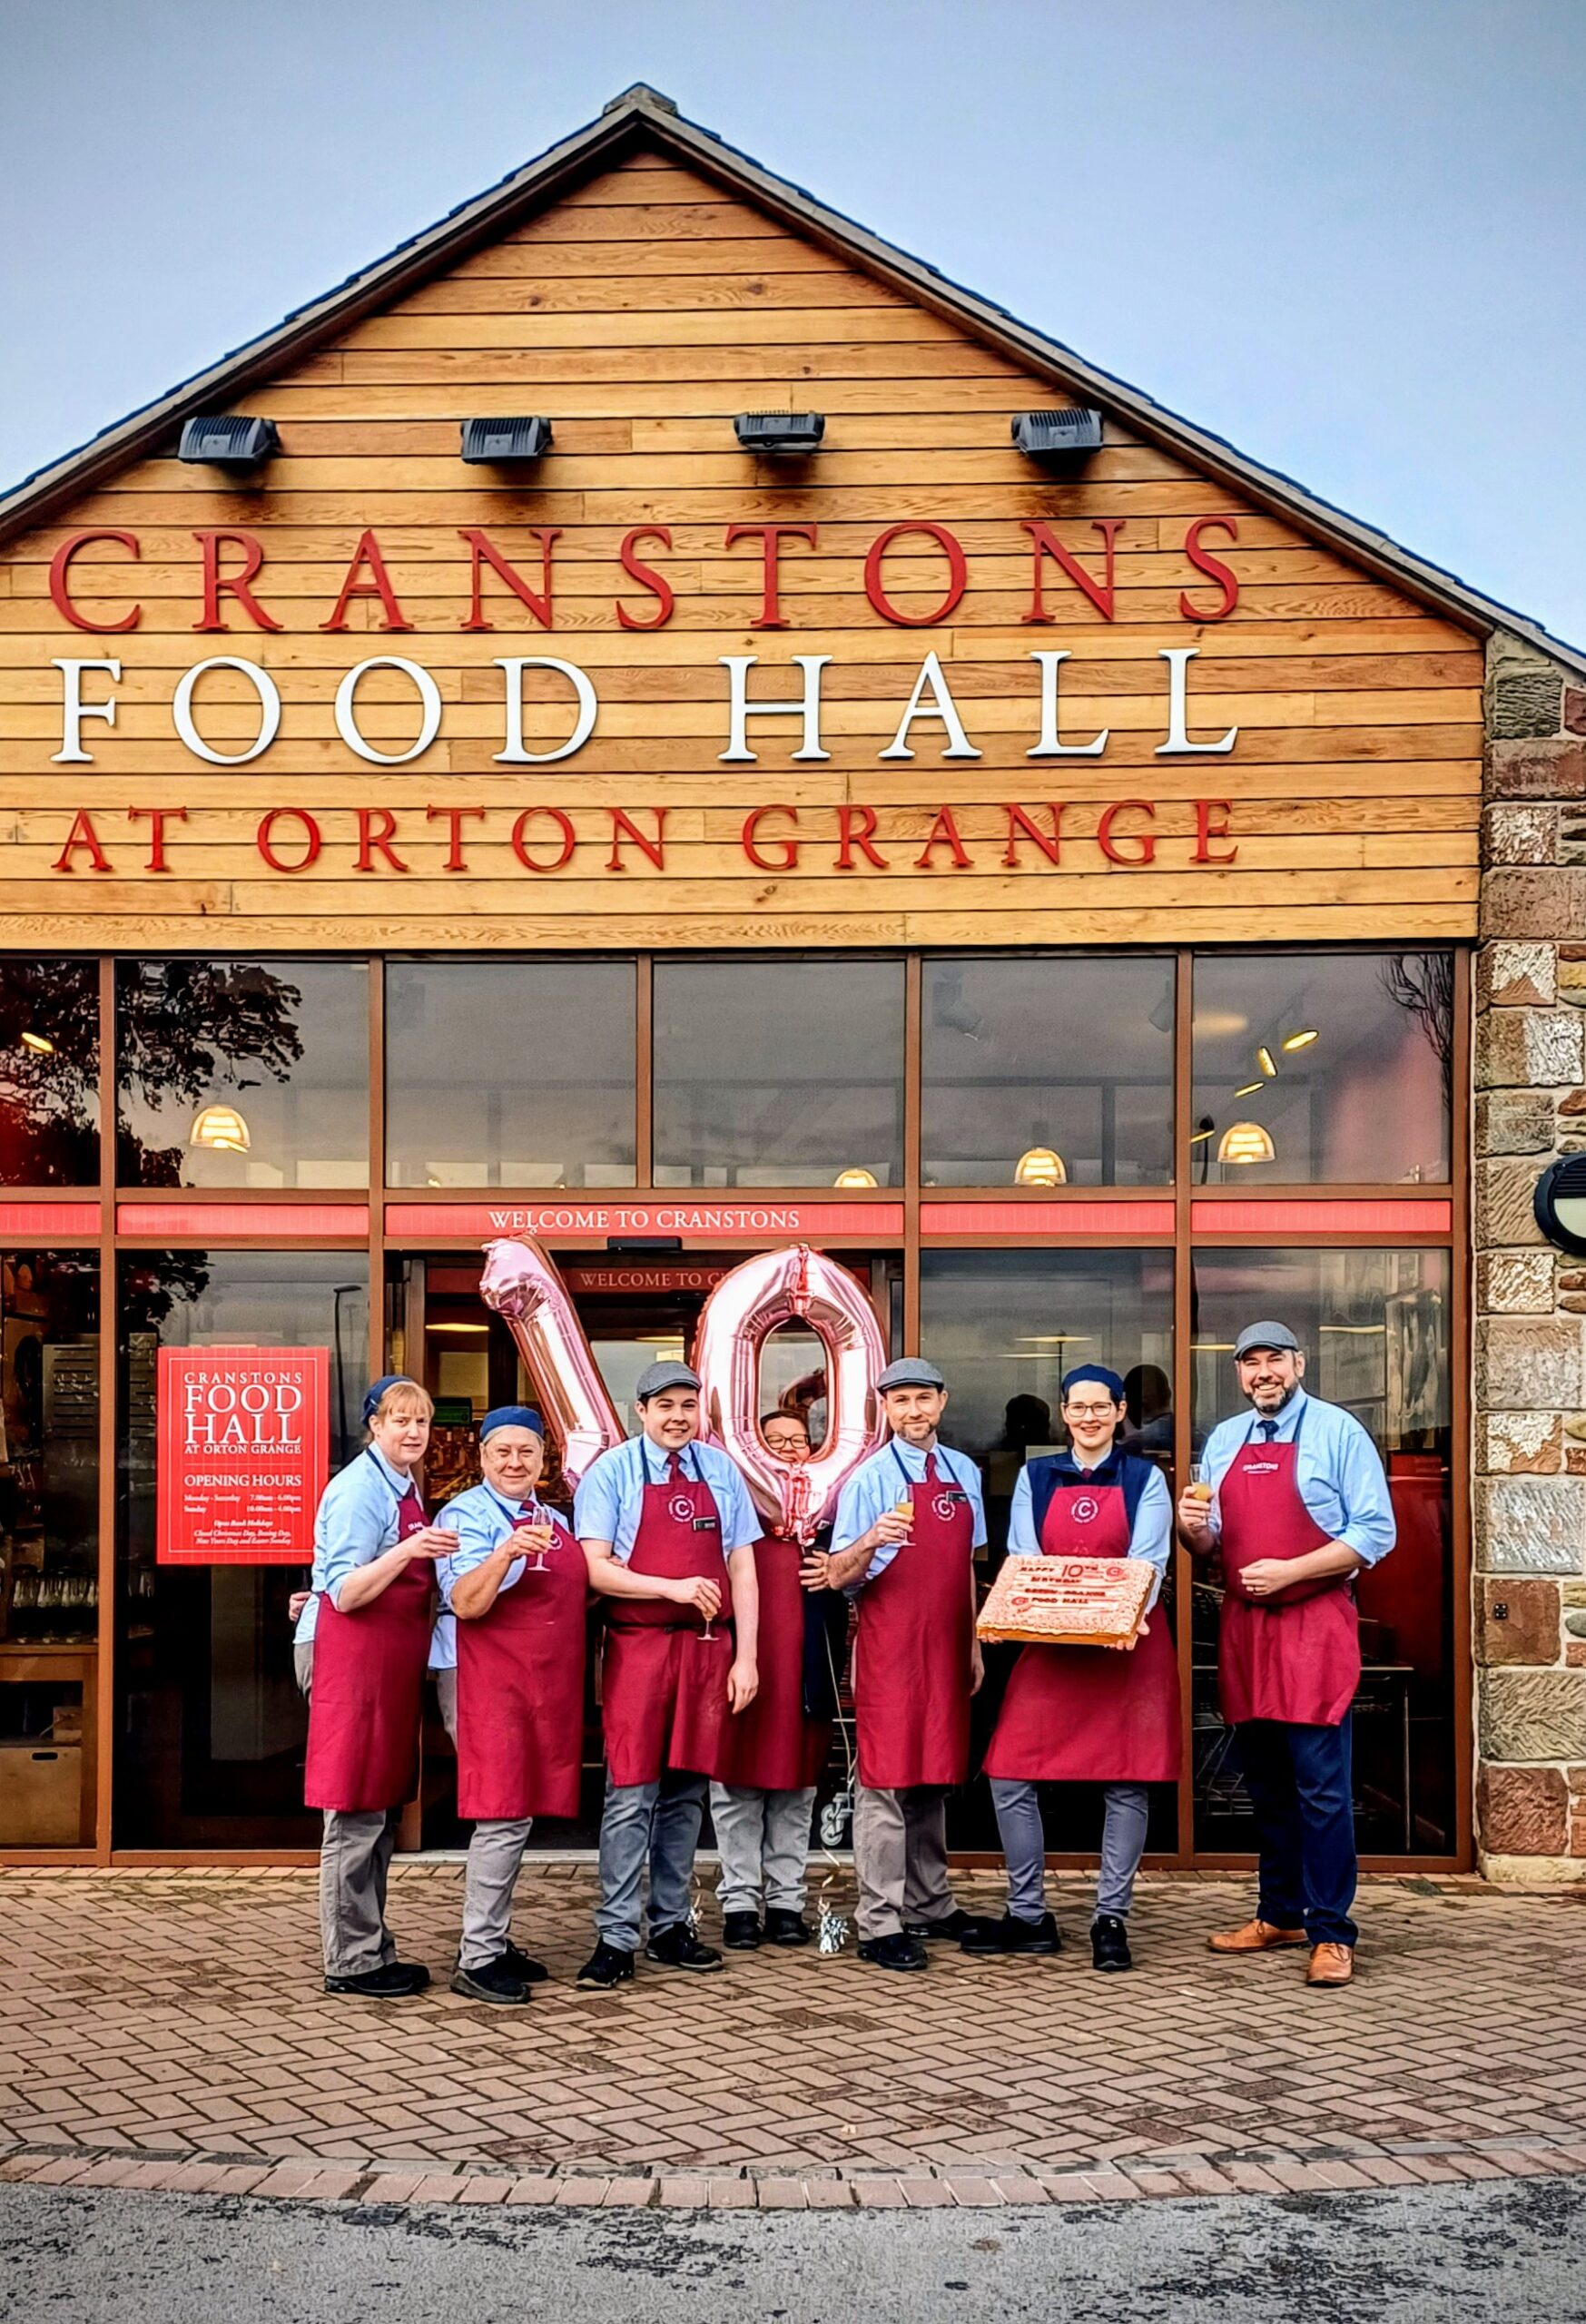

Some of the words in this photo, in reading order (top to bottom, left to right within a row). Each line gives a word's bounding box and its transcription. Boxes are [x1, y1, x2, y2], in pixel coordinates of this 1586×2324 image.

[49, 517, 1238, 633] CRANSTONS
[50, 655, 599, 765] FOOD
[717, 647, 1239, 763] HALL
[51, 804, 187, 872] AT
[257, 804, 667, 872] ORTON
[741, 799, 1240, 871] GRANGE
[488, 1210, 609, 1228] WELCOME
[615, 1210, 649, 1228] TO
[655, 1209, 801, 1228] CRANSTONS
[580, 1273, 672, 1287] WELCOME
[676, 1273, 703, 1286] TO
[184, 1372, 302, 1384] CRANSTONS
[184, 1384, 302, 1413] FOOD
[184, 1413, 302, 1445] HALL
[184, 1444, 200, 1454] AT
[203, 1444, 247, 1454] ORTON
[251, 1444, 302, 1454] GRANGE
[184, 1474, 250, 1487] OPENING
[252, 1474, 301, 1487] HOURS
